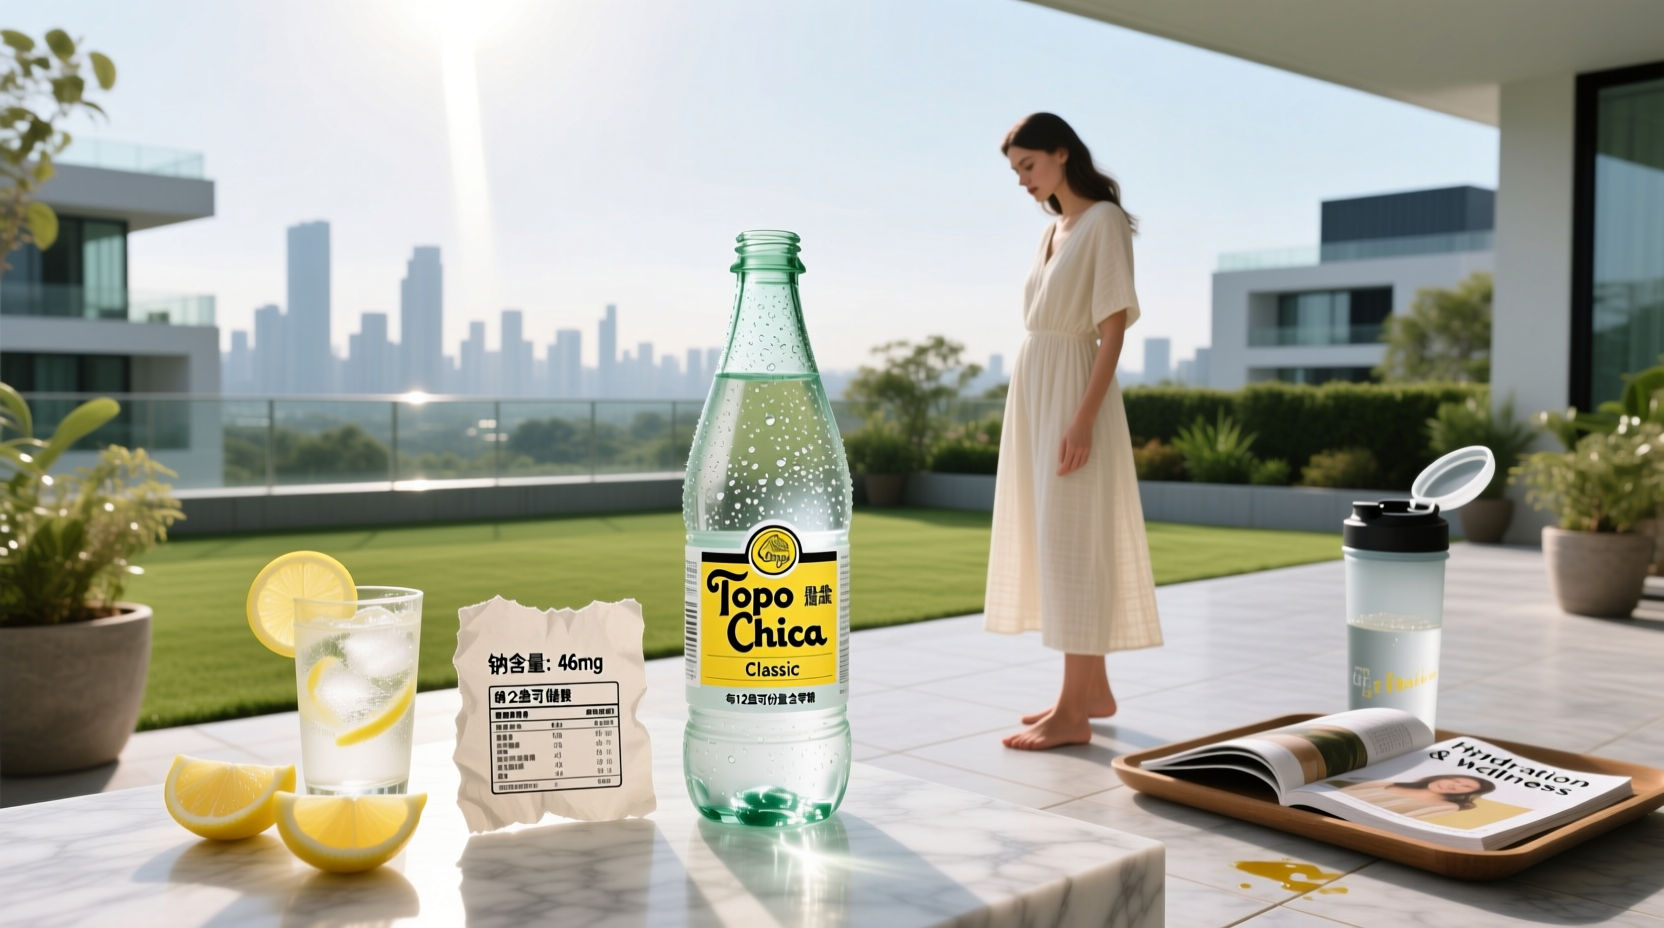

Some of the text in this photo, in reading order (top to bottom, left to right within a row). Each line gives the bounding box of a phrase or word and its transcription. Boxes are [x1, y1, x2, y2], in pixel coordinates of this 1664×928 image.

[707, 569, 794, 616] Topo
[727, 611, 828, 653] Chica
[558, 653, 603, 675] 46mg
[745, 661, 800, 677] Classic
[1429, 750, 1450, 761] &
